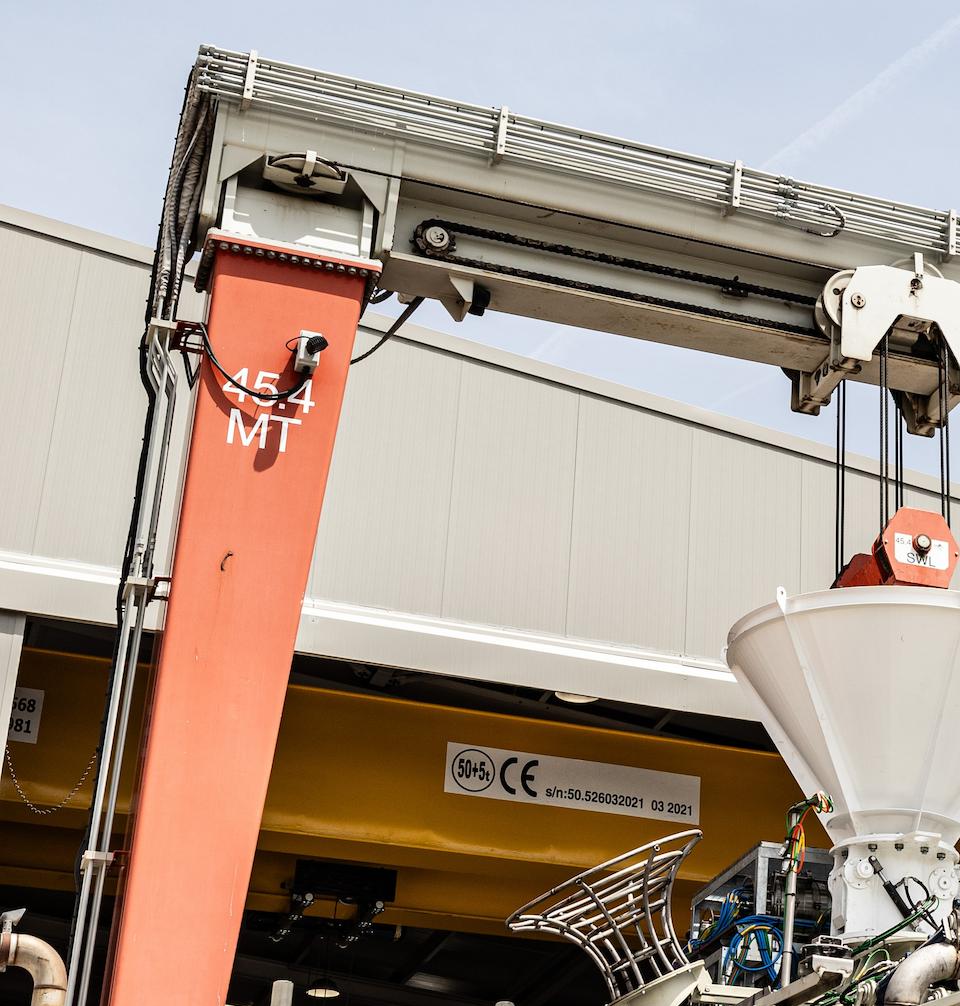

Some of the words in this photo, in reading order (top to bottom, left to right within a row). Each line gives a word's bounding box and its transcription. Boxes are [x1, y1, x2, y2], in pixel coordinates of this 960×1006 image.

[222, 367, 315, 414] 45.4
[226, 408, 302, 453] MT
[906, 552, 936, 567] SWL
[457, 758, 490, 783] 50+5t
[499, 757, 539, 798] CE
[545, 786, 644, 809] s/n:50.526032021
[651, 800, 664, 813] 03
[667, 803, 693, 816] 2021
